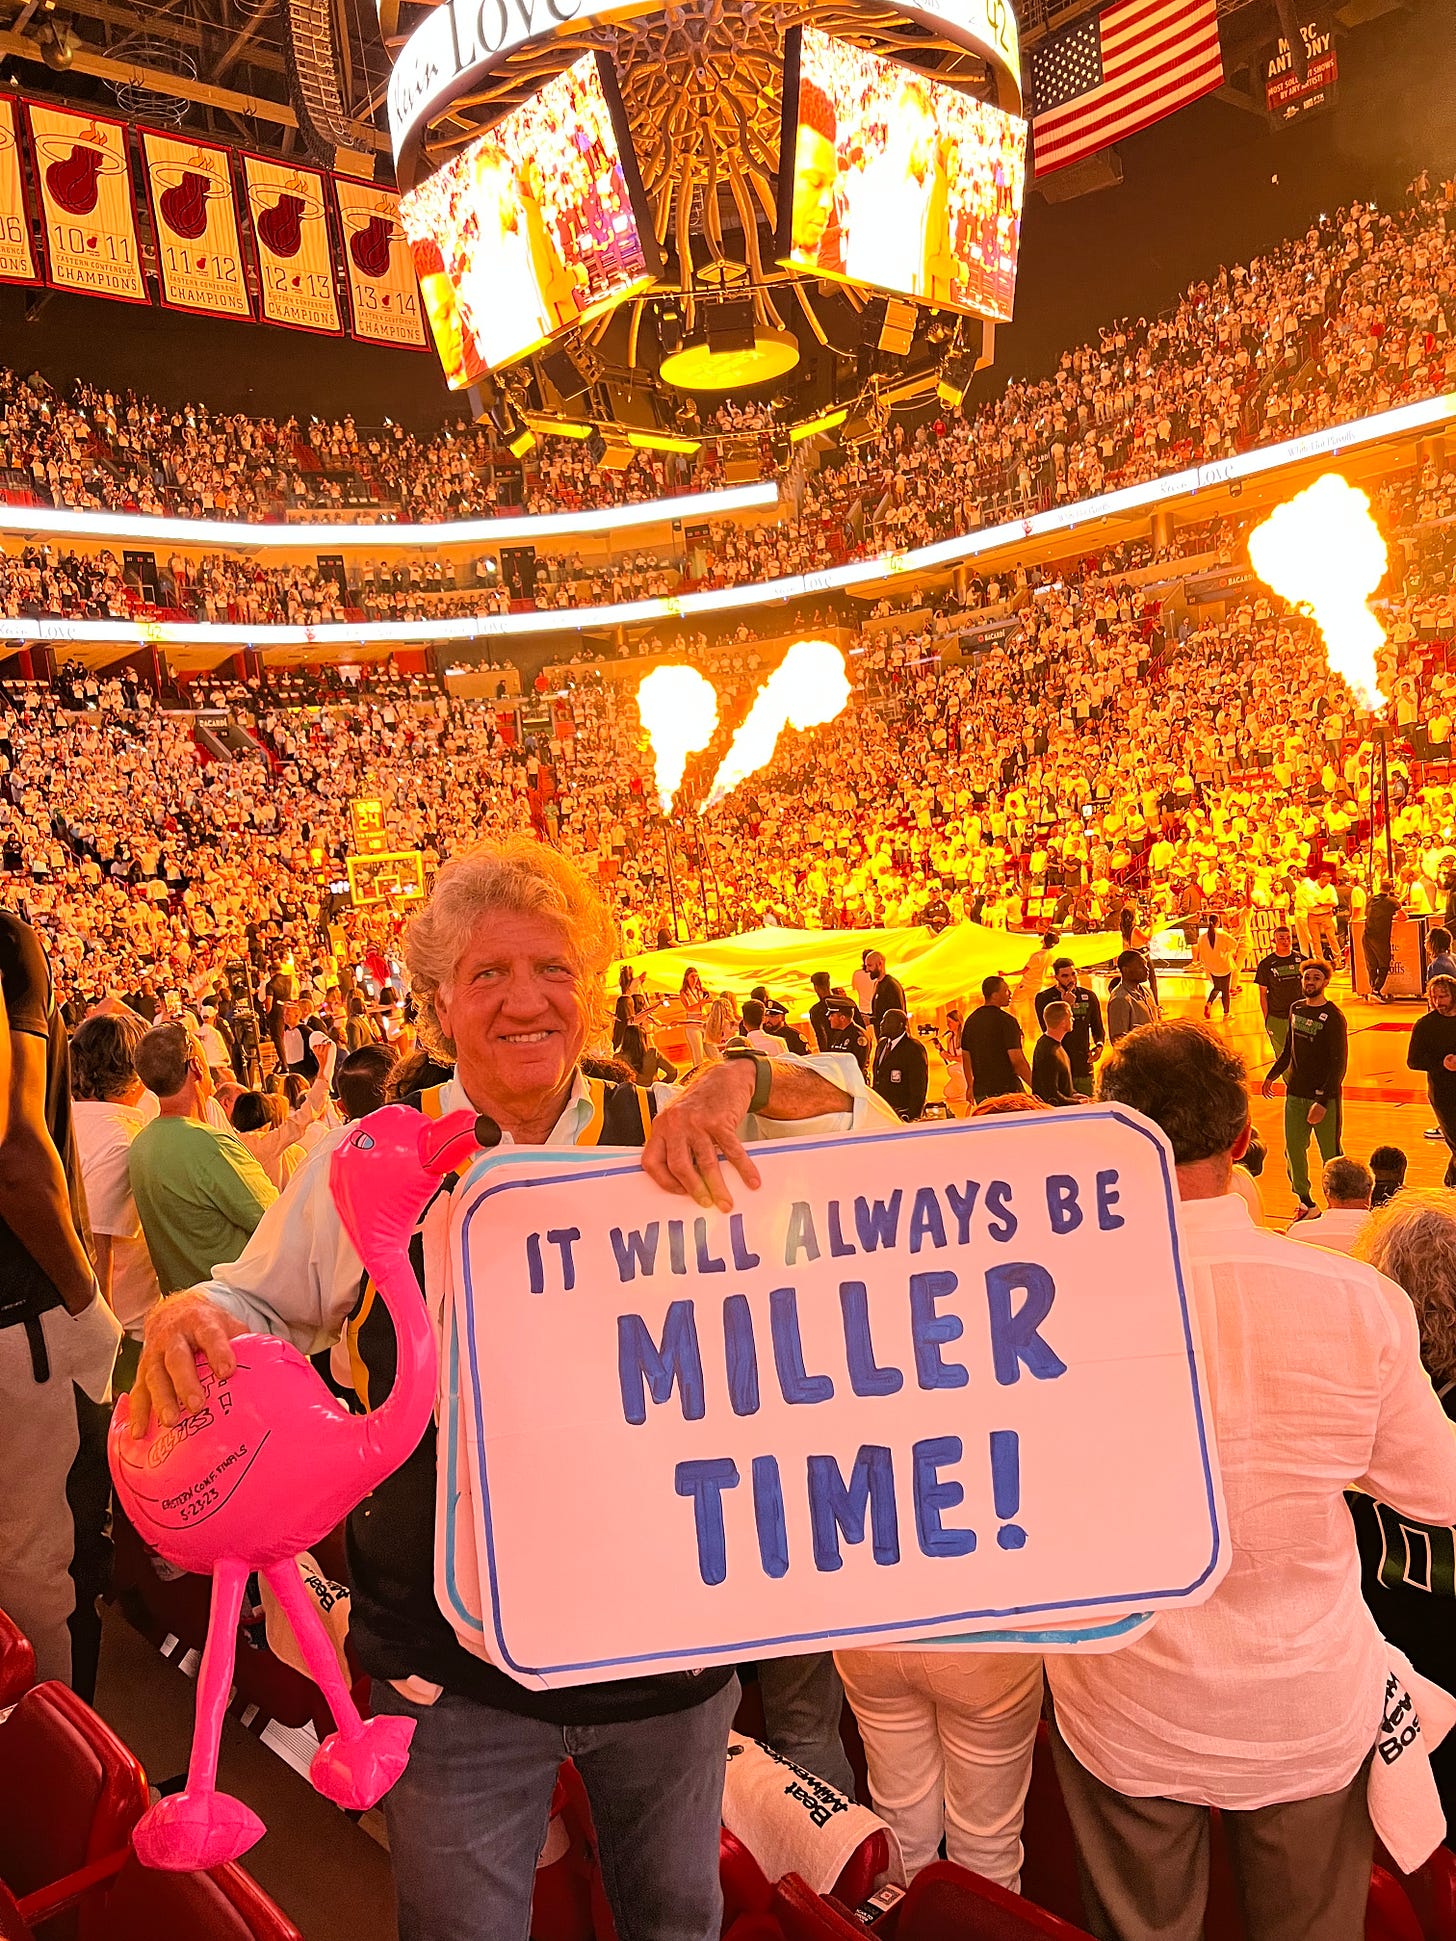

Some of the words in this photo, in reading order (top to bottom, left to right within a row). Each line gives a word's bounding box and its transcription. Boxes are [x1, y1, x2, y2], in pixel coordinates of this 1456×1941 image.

[54, 225, 85, 254] 10
[106, 235, 132, 264] 11
[56, 264, 137, 291] CHAMPIONS
[166, 247, 192, 276] 11
[212, 256, 237, 283] 12
[265, 265, 288, 292] 12
[306, 274, 331, 299] 13
[170, 285, 244, 309] CHAMPIONS
[268, 302, 335, 325] CHAMPIONS
[355, 284, 378, 310] 13
[396, 292, 417, 316] 14
[358, 320, 421, 340] CHAMPIONS
[358, 813, 380, 831] 24
[526, 1227, 581, 1295] IT
[610, 1212, 761, 1283] WILL
[784, 1179, 1018, 1267] ALWAYS
[1045, 1168, 1126, 1235] BE
[616, 1261, 1069, 1426] MILLER
[674, 1429, 1029, 1587] TIME!
[303, 1575, 336, 1614] Beat
[784, 1781, 833, 1829] Beat
